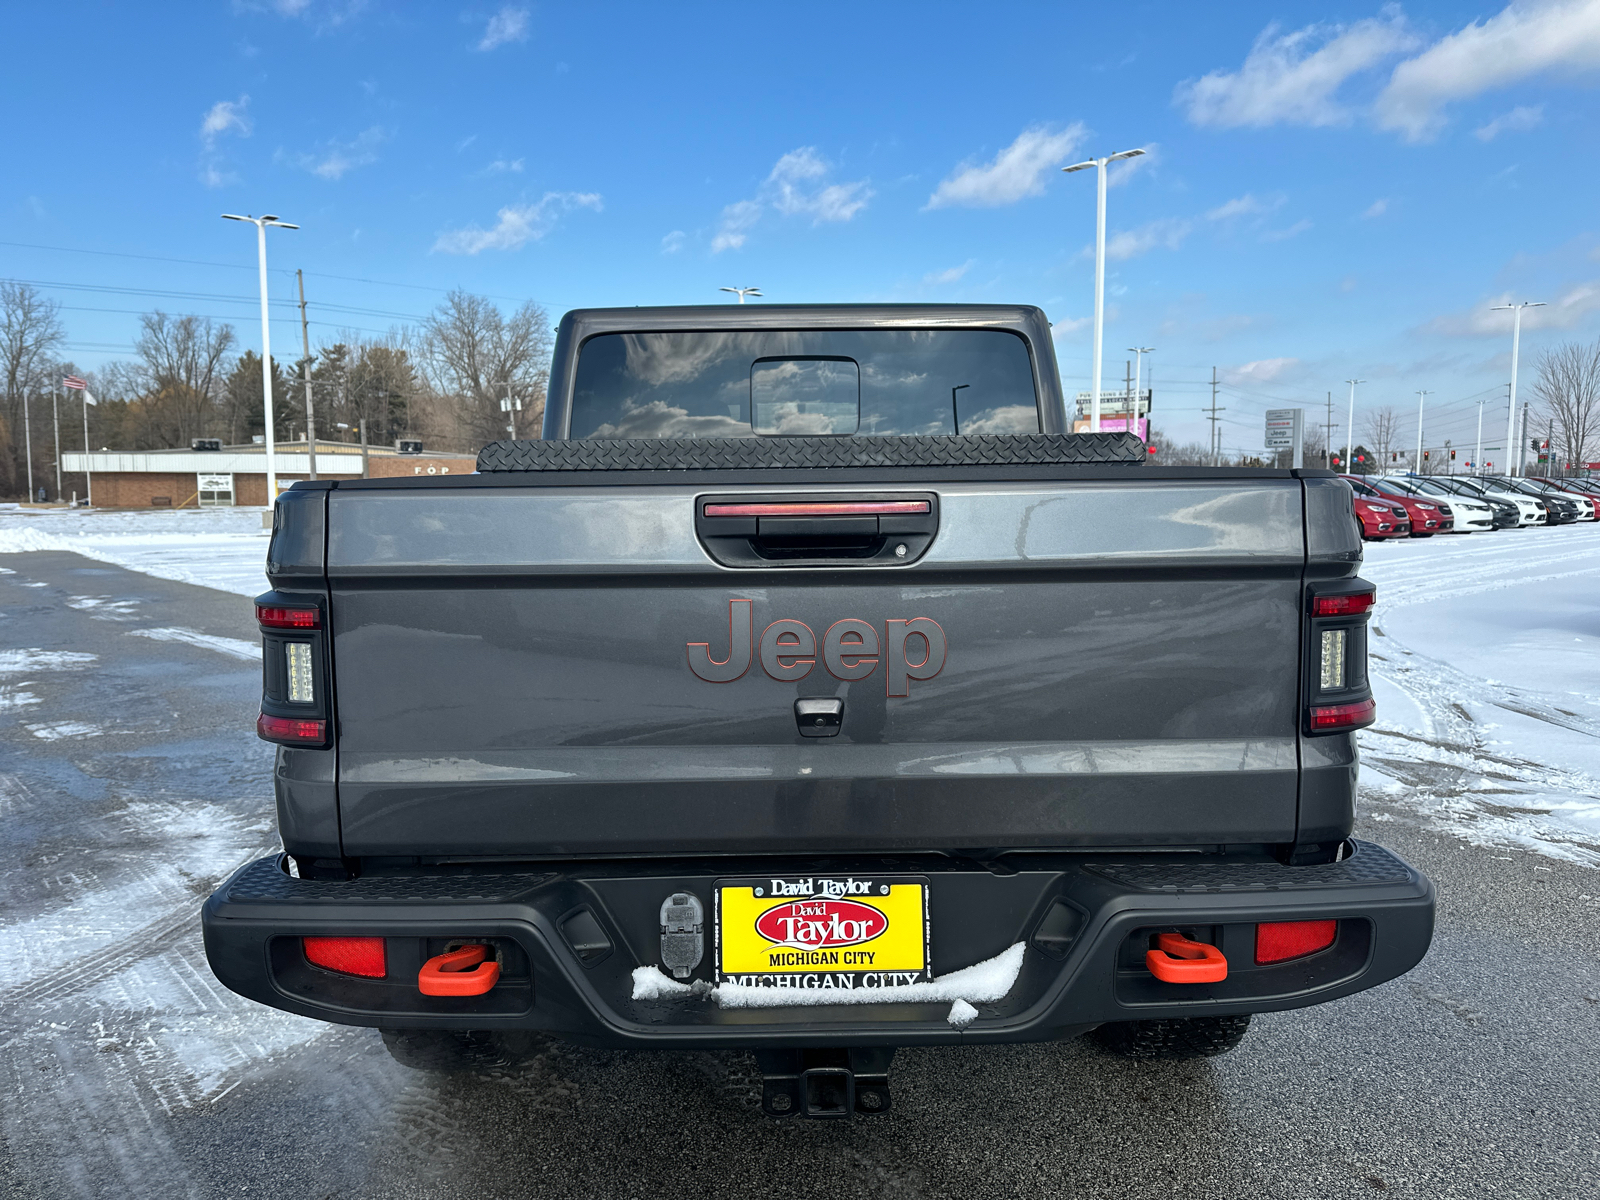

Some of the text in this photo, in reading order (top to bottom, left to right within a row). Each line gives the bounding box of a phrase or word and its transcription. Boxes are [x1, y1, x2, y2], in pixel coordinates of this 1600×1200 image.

[686, 599, 948, 697] Jeep
[770, 878, 873, 899] David Taylor
[791, 903, 827, 917] David
[776, 912, 875, 947] Taylor
[769, 951, 876, 967] MICHIGAN CITY
[726, 972, 920, 990] MICHIGAN CITY
